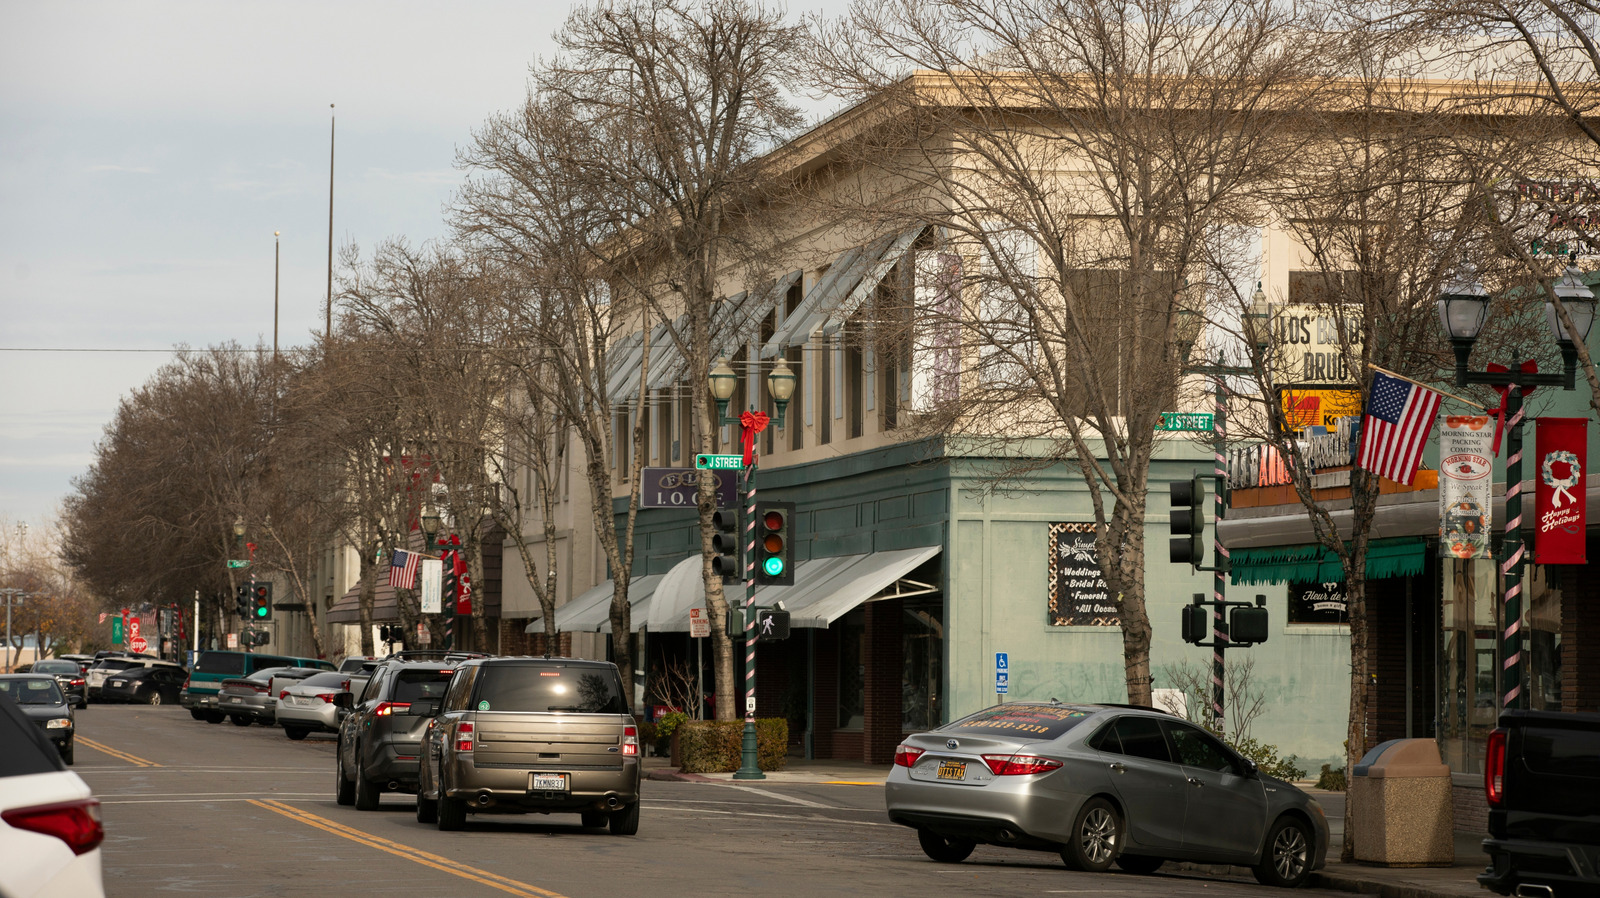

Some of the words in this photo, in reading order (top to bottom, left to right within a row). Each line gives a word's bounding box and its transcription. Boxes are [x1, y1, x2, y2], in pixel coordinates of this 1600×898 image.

[1281, 316, 1310, 345] LOS
[1317, 316, 1365, 345] BAO
[1304, 352, 1348, 381] DRUG
[1168, 415, 1173, 429] J
[1176, 415, 1209, 429] STREET
[709, 457, 714, 468] J
[715, 457, 742, 468] STREET
[1445, 456, 1472, 466] MORNING
[1472, 456, 1487, 467] STAR
[1541, 508, 1571, 523] Happy
[1541, 514, 1580, 533] Holidays
[1073, 537, 1098, 551] Simpl
[1064, 567, 1101, 578] Weddings
[1069, 579, 1095, 588] Bridal
[1097, 579, 1109, 589] Ro
[1074, 591, 1108, 600] Funerals
[1302, 590, 1328, 601] Fleur
[1330, 591, 1341, 601] de
[1079, 604, 1092, 612] All
